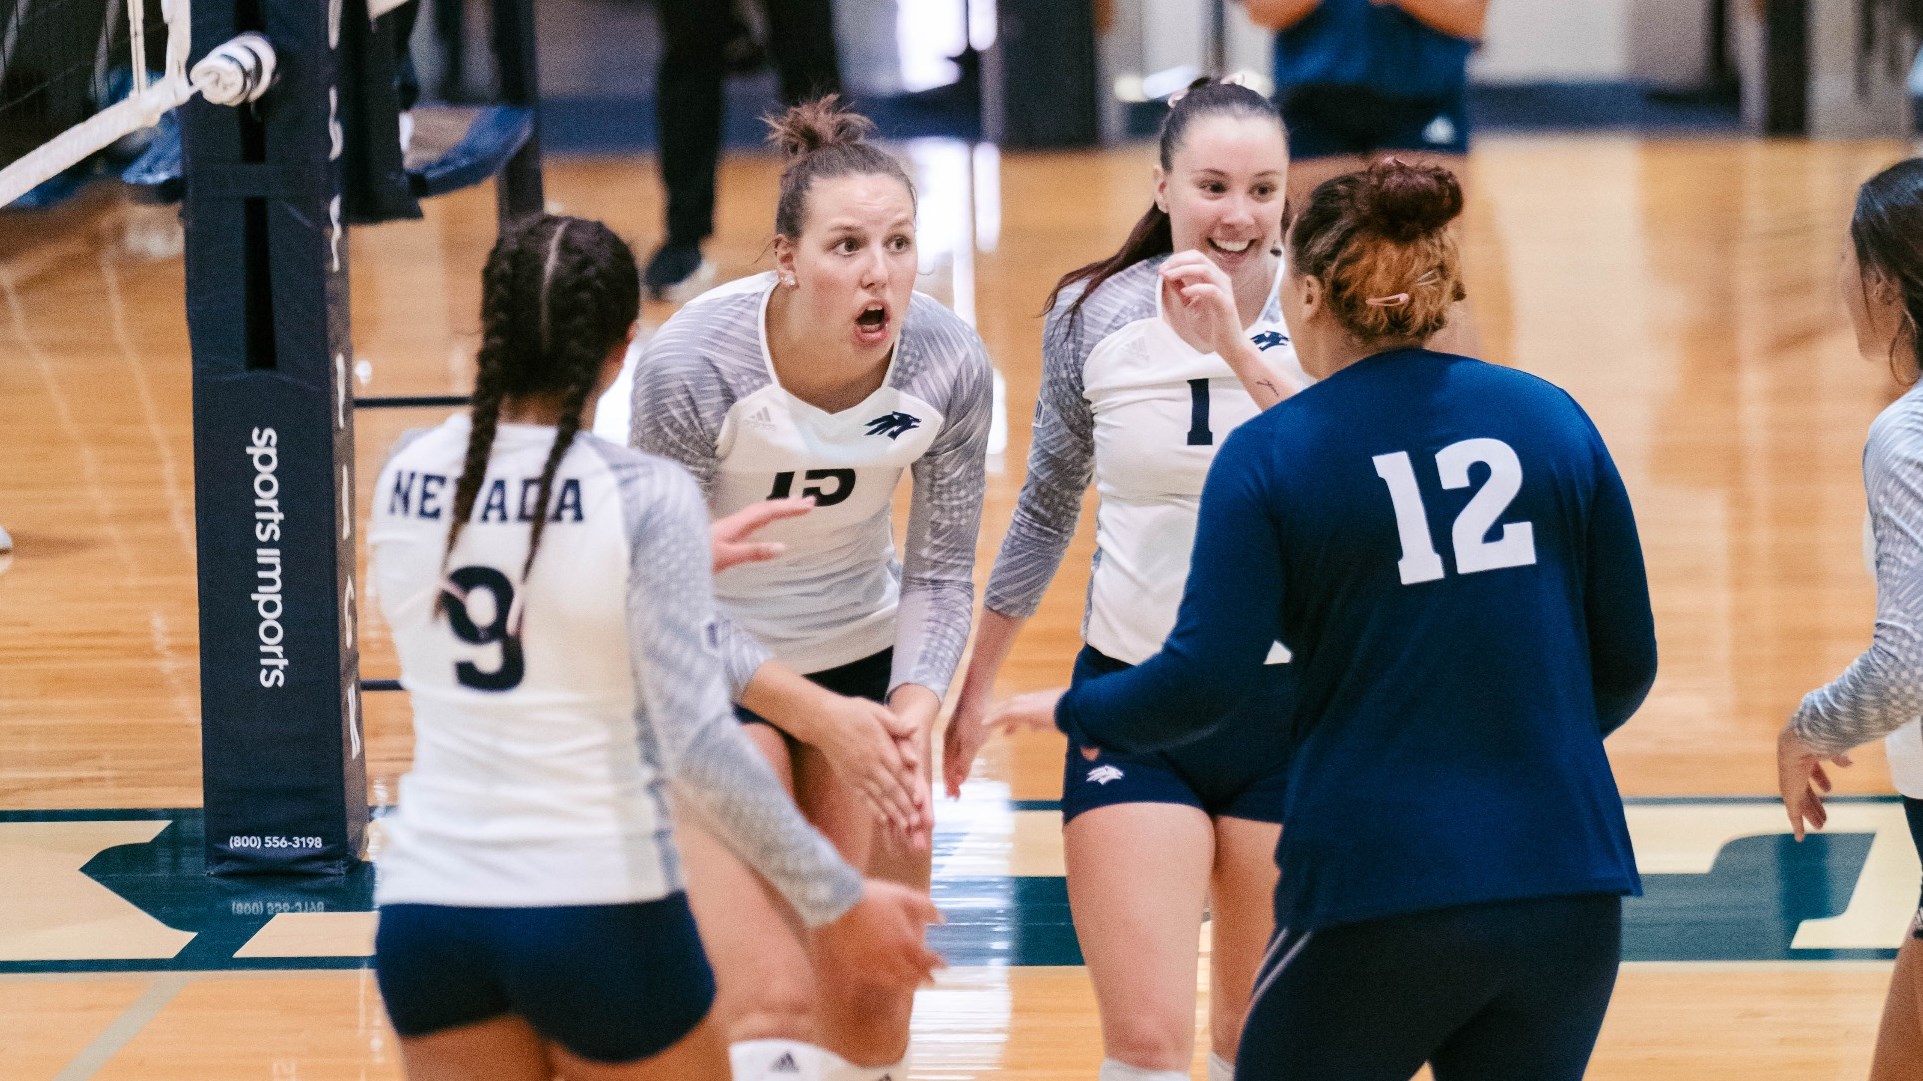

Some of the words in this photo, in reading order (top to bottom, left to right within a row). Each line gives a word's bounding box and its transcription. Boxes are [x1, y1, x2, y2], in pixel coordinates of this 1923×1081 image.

[1187, 378, 1213, 445] 1
[246, 426, 284, 542] sports
[388, 470, 584, 523] NEADA
[1372, 437, 1537, 585] 12
[443, 565, 526, 692] 9
[229, 836, 261, 849] (800)
[264, 836, 322, 849] 556-3198
